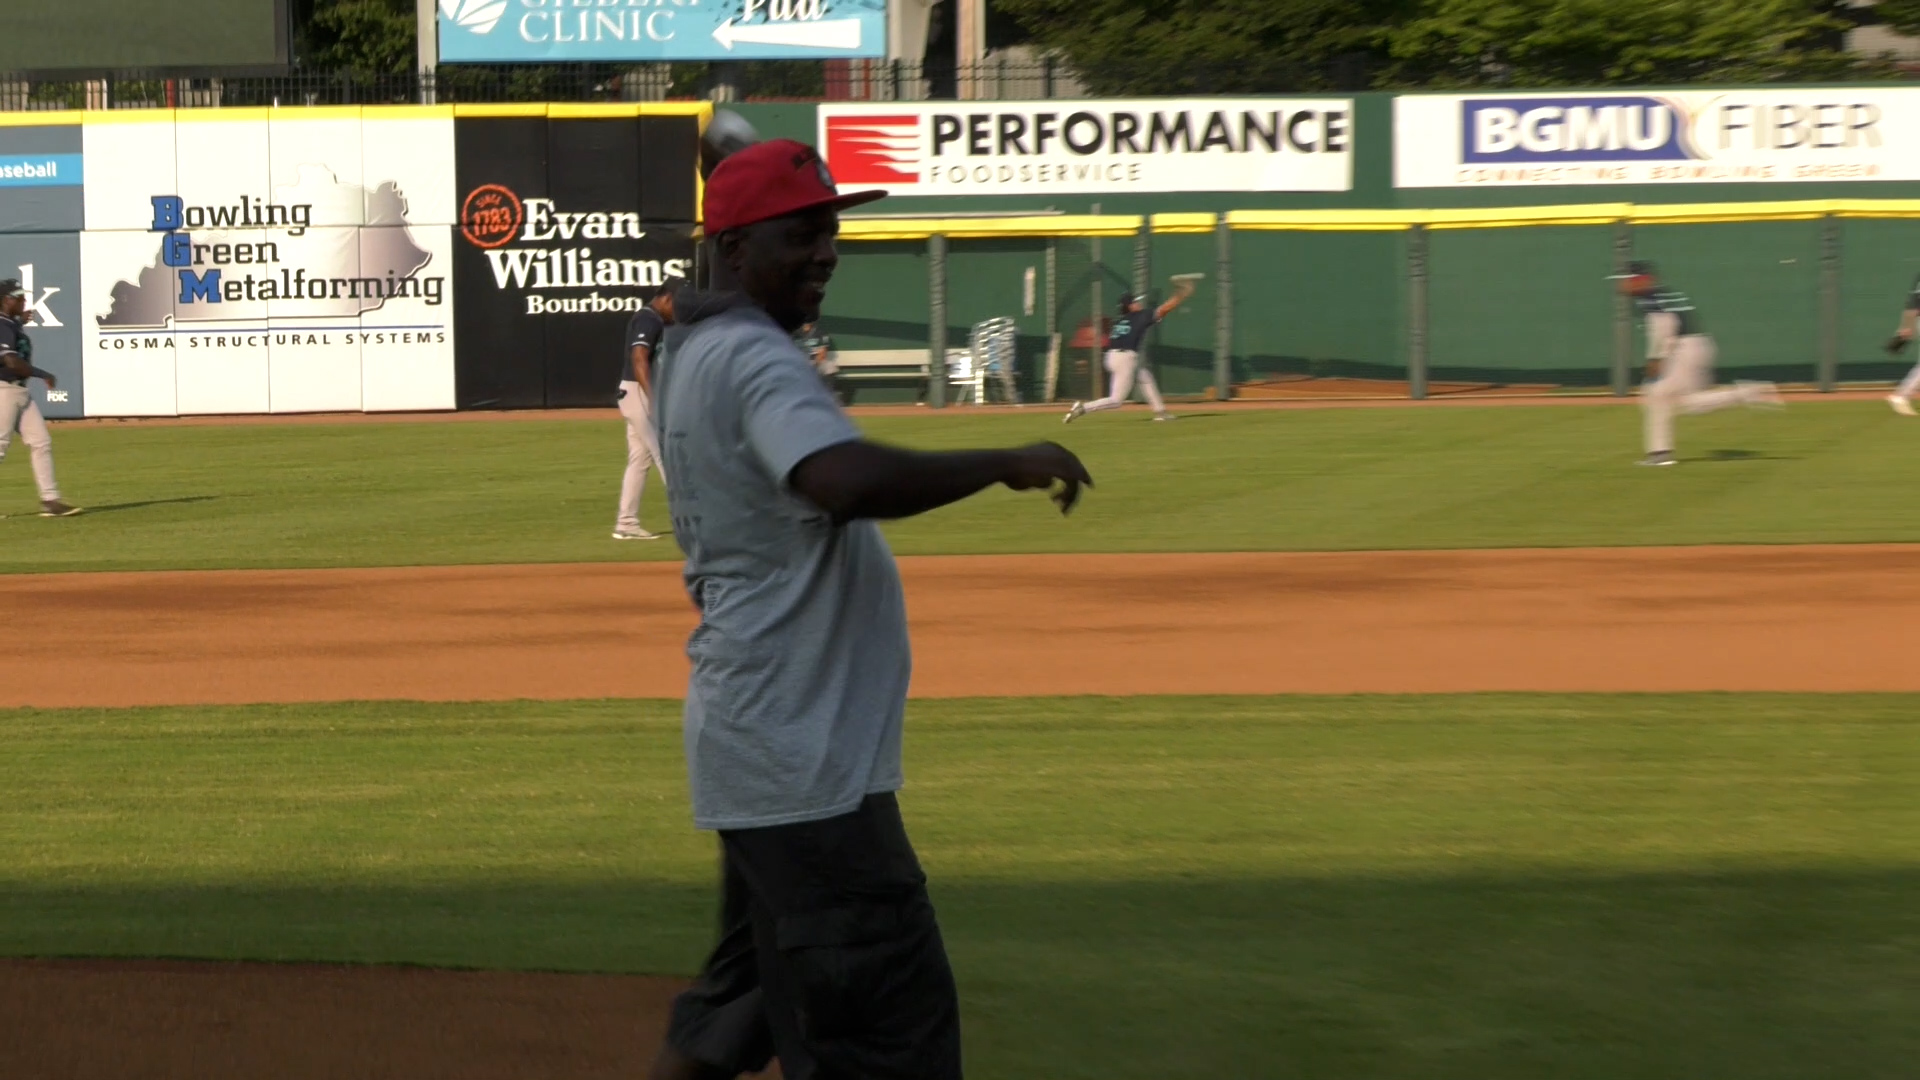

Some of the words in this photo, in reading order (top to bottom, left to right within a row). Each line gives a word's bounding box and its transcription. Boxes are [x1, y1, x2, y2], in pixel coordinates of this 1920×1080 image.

[519, 9, 676, 43] CLINIC
[930, 110, 1350, 157] PERFORMANCE
[1474, 103, 1672, 154] BGMU
[1719, 103, 1883, 149] FIBER
[930, 162, 1142, 184] FOODSERVICE
[1457, 166, 1628, 183] CONNECTNG
[1650, 165, 1776, 180] BOWLNG
[150, 194, 312, 237] Bowling
[472, 207, 511, 236] 1783
[520, 198, 646, 241] Evan
[162, 232, 280, 267] Green
[484, 247, 686, 289] Williams
[178, 268, 445, 306] Metalforming
[526, 292, 644, 315] Bourbon
[98, 338, 176, 350] COSMA
[189, 335, 331, 349] STRUCTURAL
[345, 332, 446, 345] SYSTEMS
[47, 392, 69, 402] FDIC
